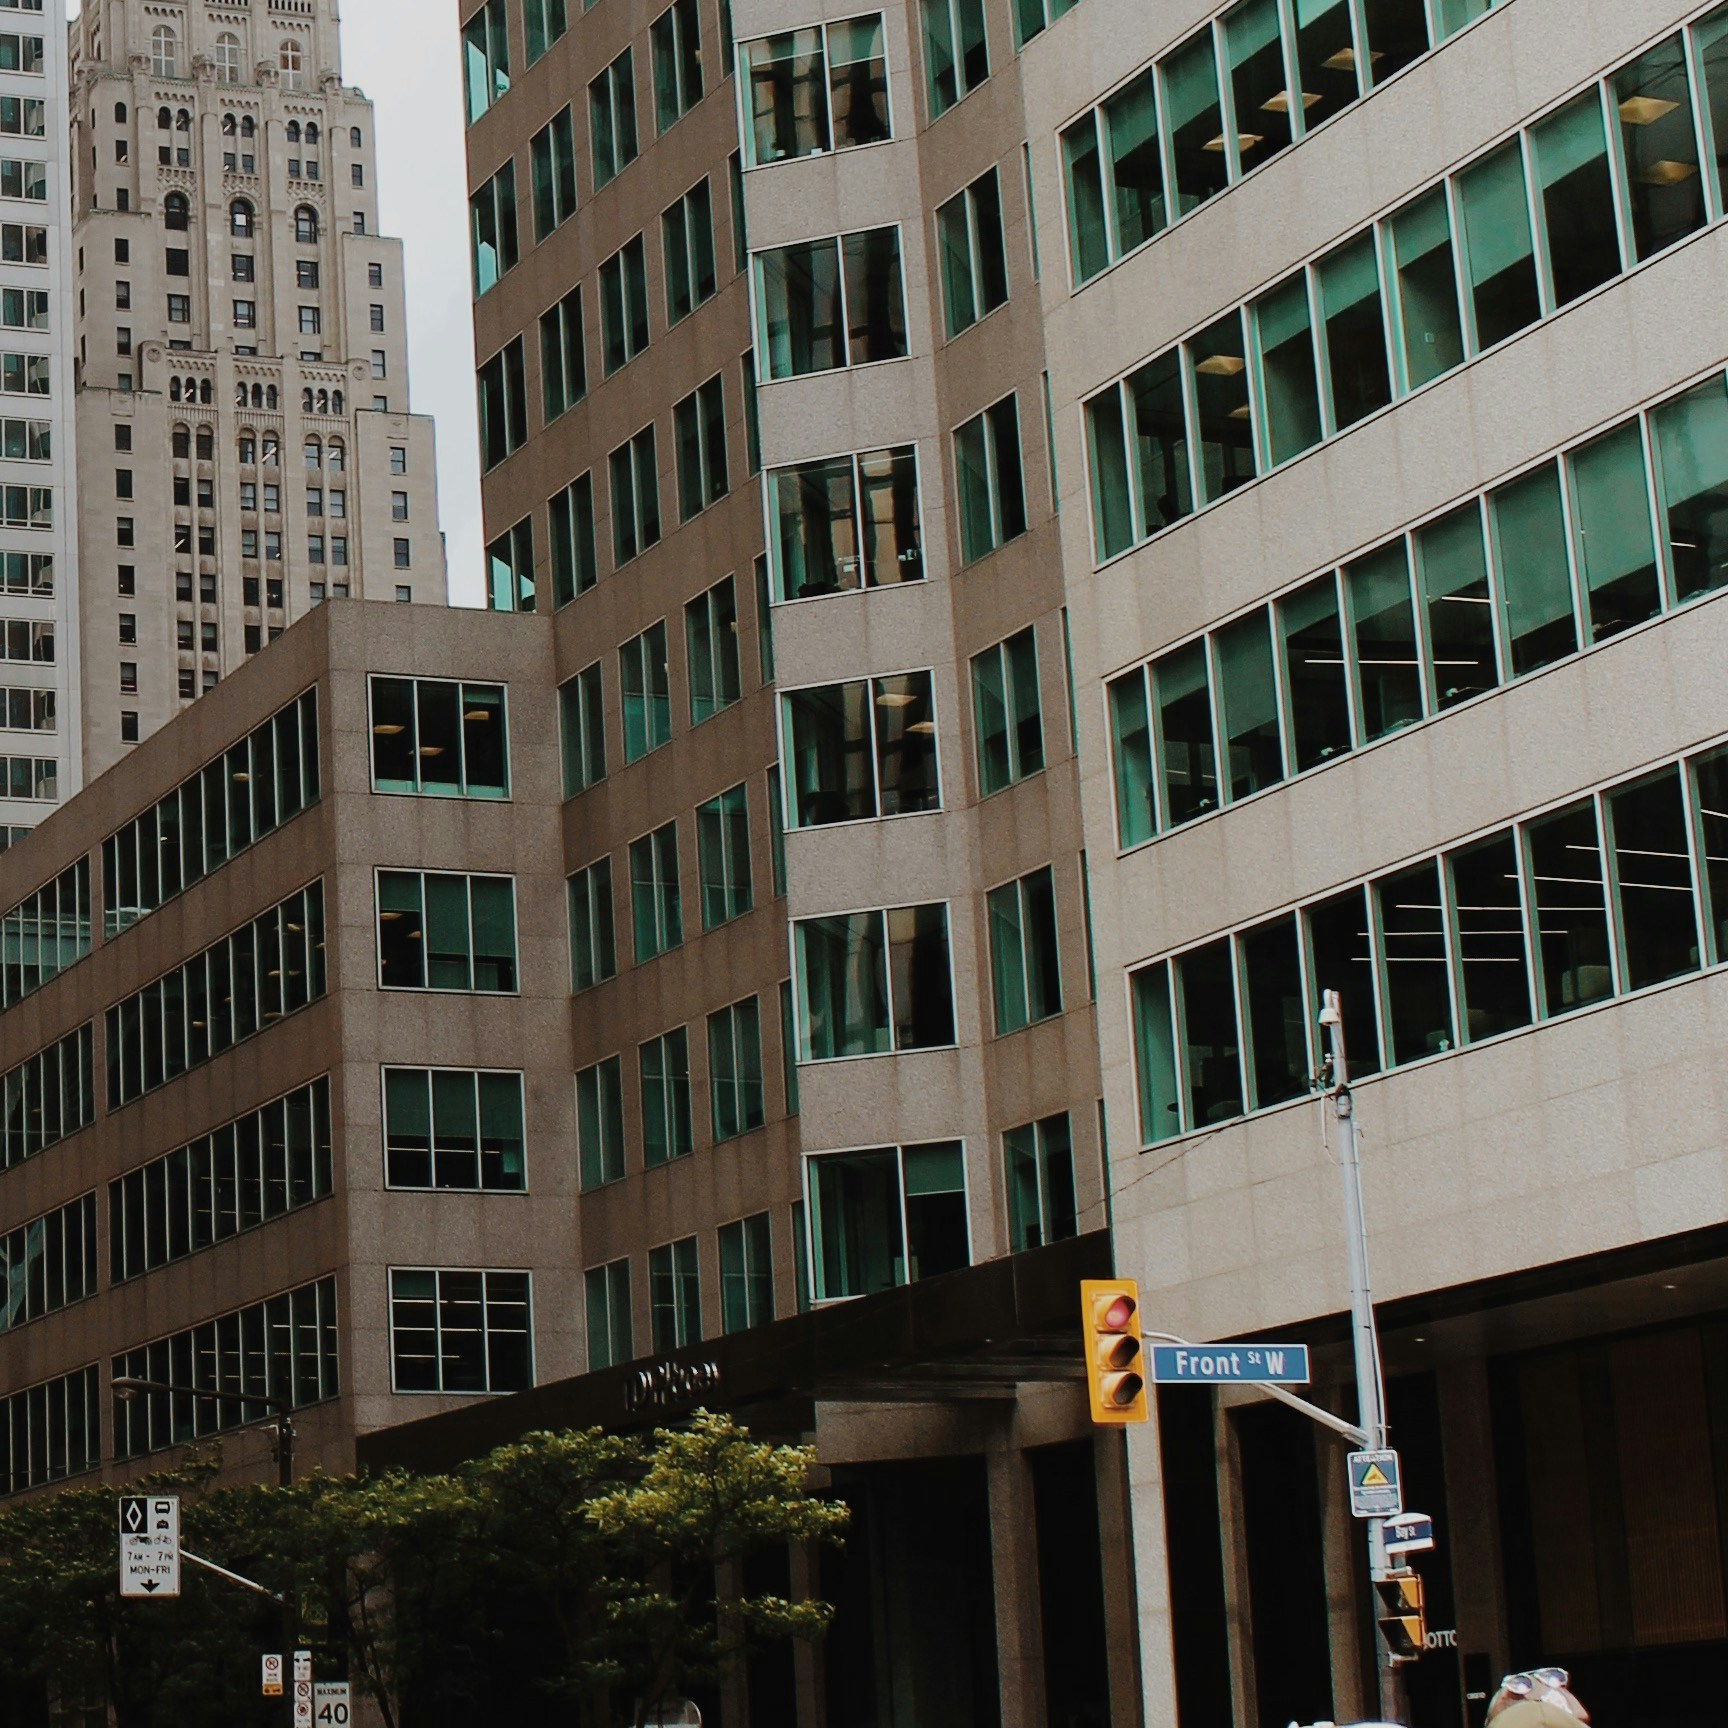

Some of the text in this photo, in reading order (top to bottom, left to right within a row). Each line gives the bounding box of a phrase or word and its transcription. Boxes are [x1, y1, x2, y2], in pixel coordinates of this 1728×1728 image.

[1176, 1350, 1284, 1375] Front St W
[318, 1703, 349, 1724] 40
